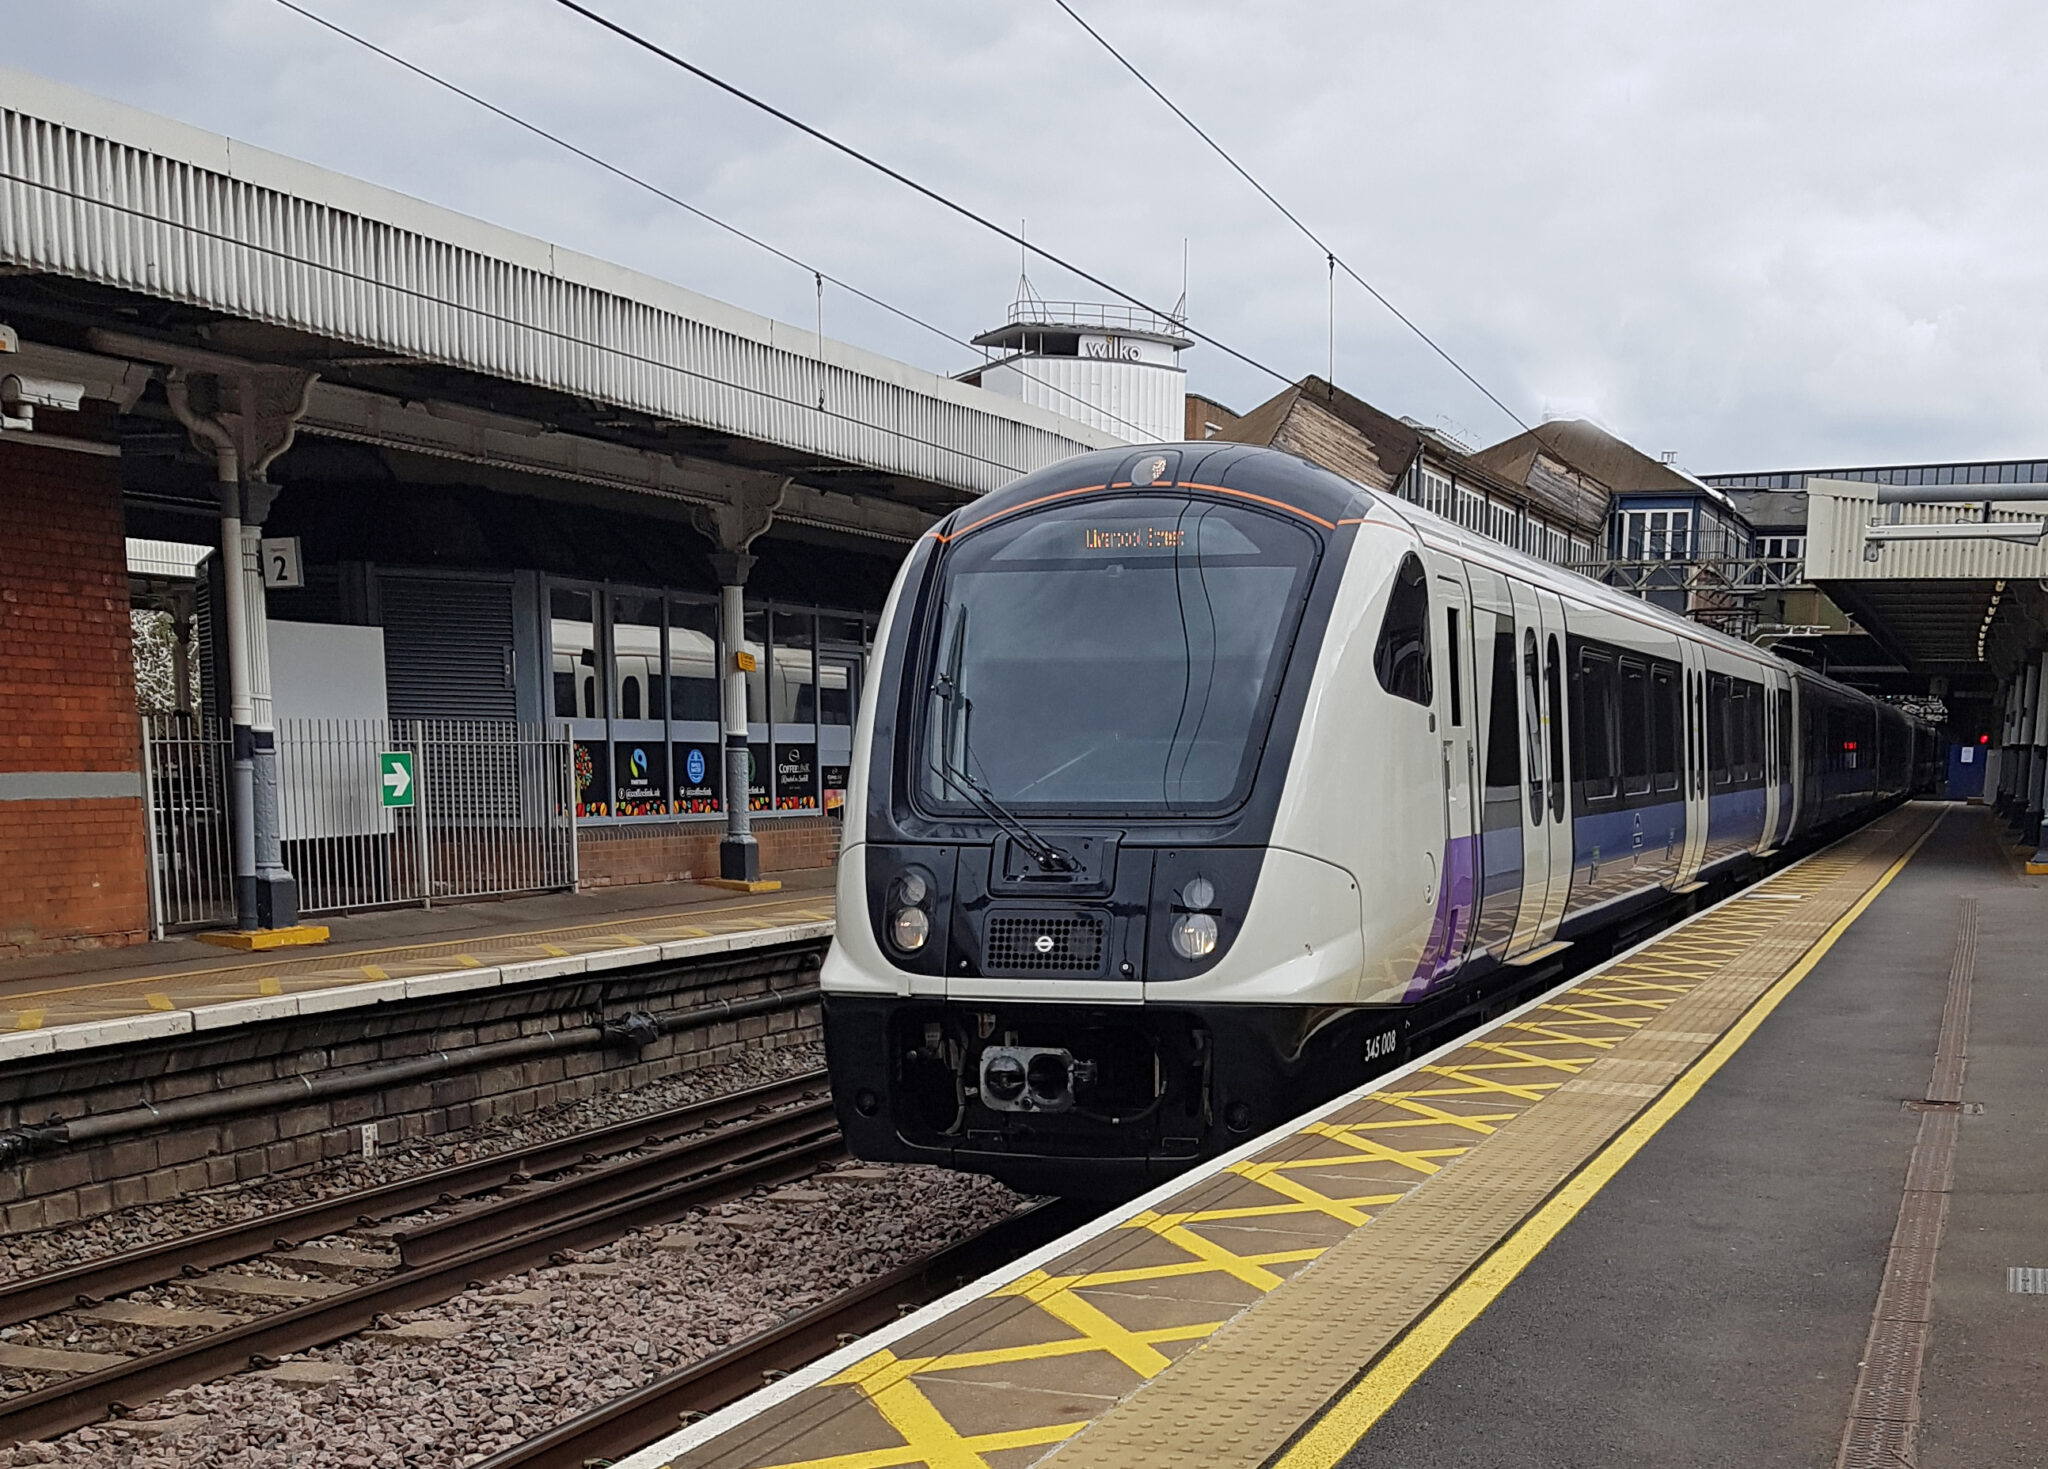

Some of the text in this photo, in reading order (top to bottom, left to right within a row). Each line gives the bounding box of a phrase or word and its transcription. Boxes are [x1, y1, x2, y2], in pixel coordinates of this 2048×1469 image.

[1086, 336, 1141, 361] wilko
[273, 555, 288, 581] 2
[1365, 1029, 1396, 1062] 345 008
